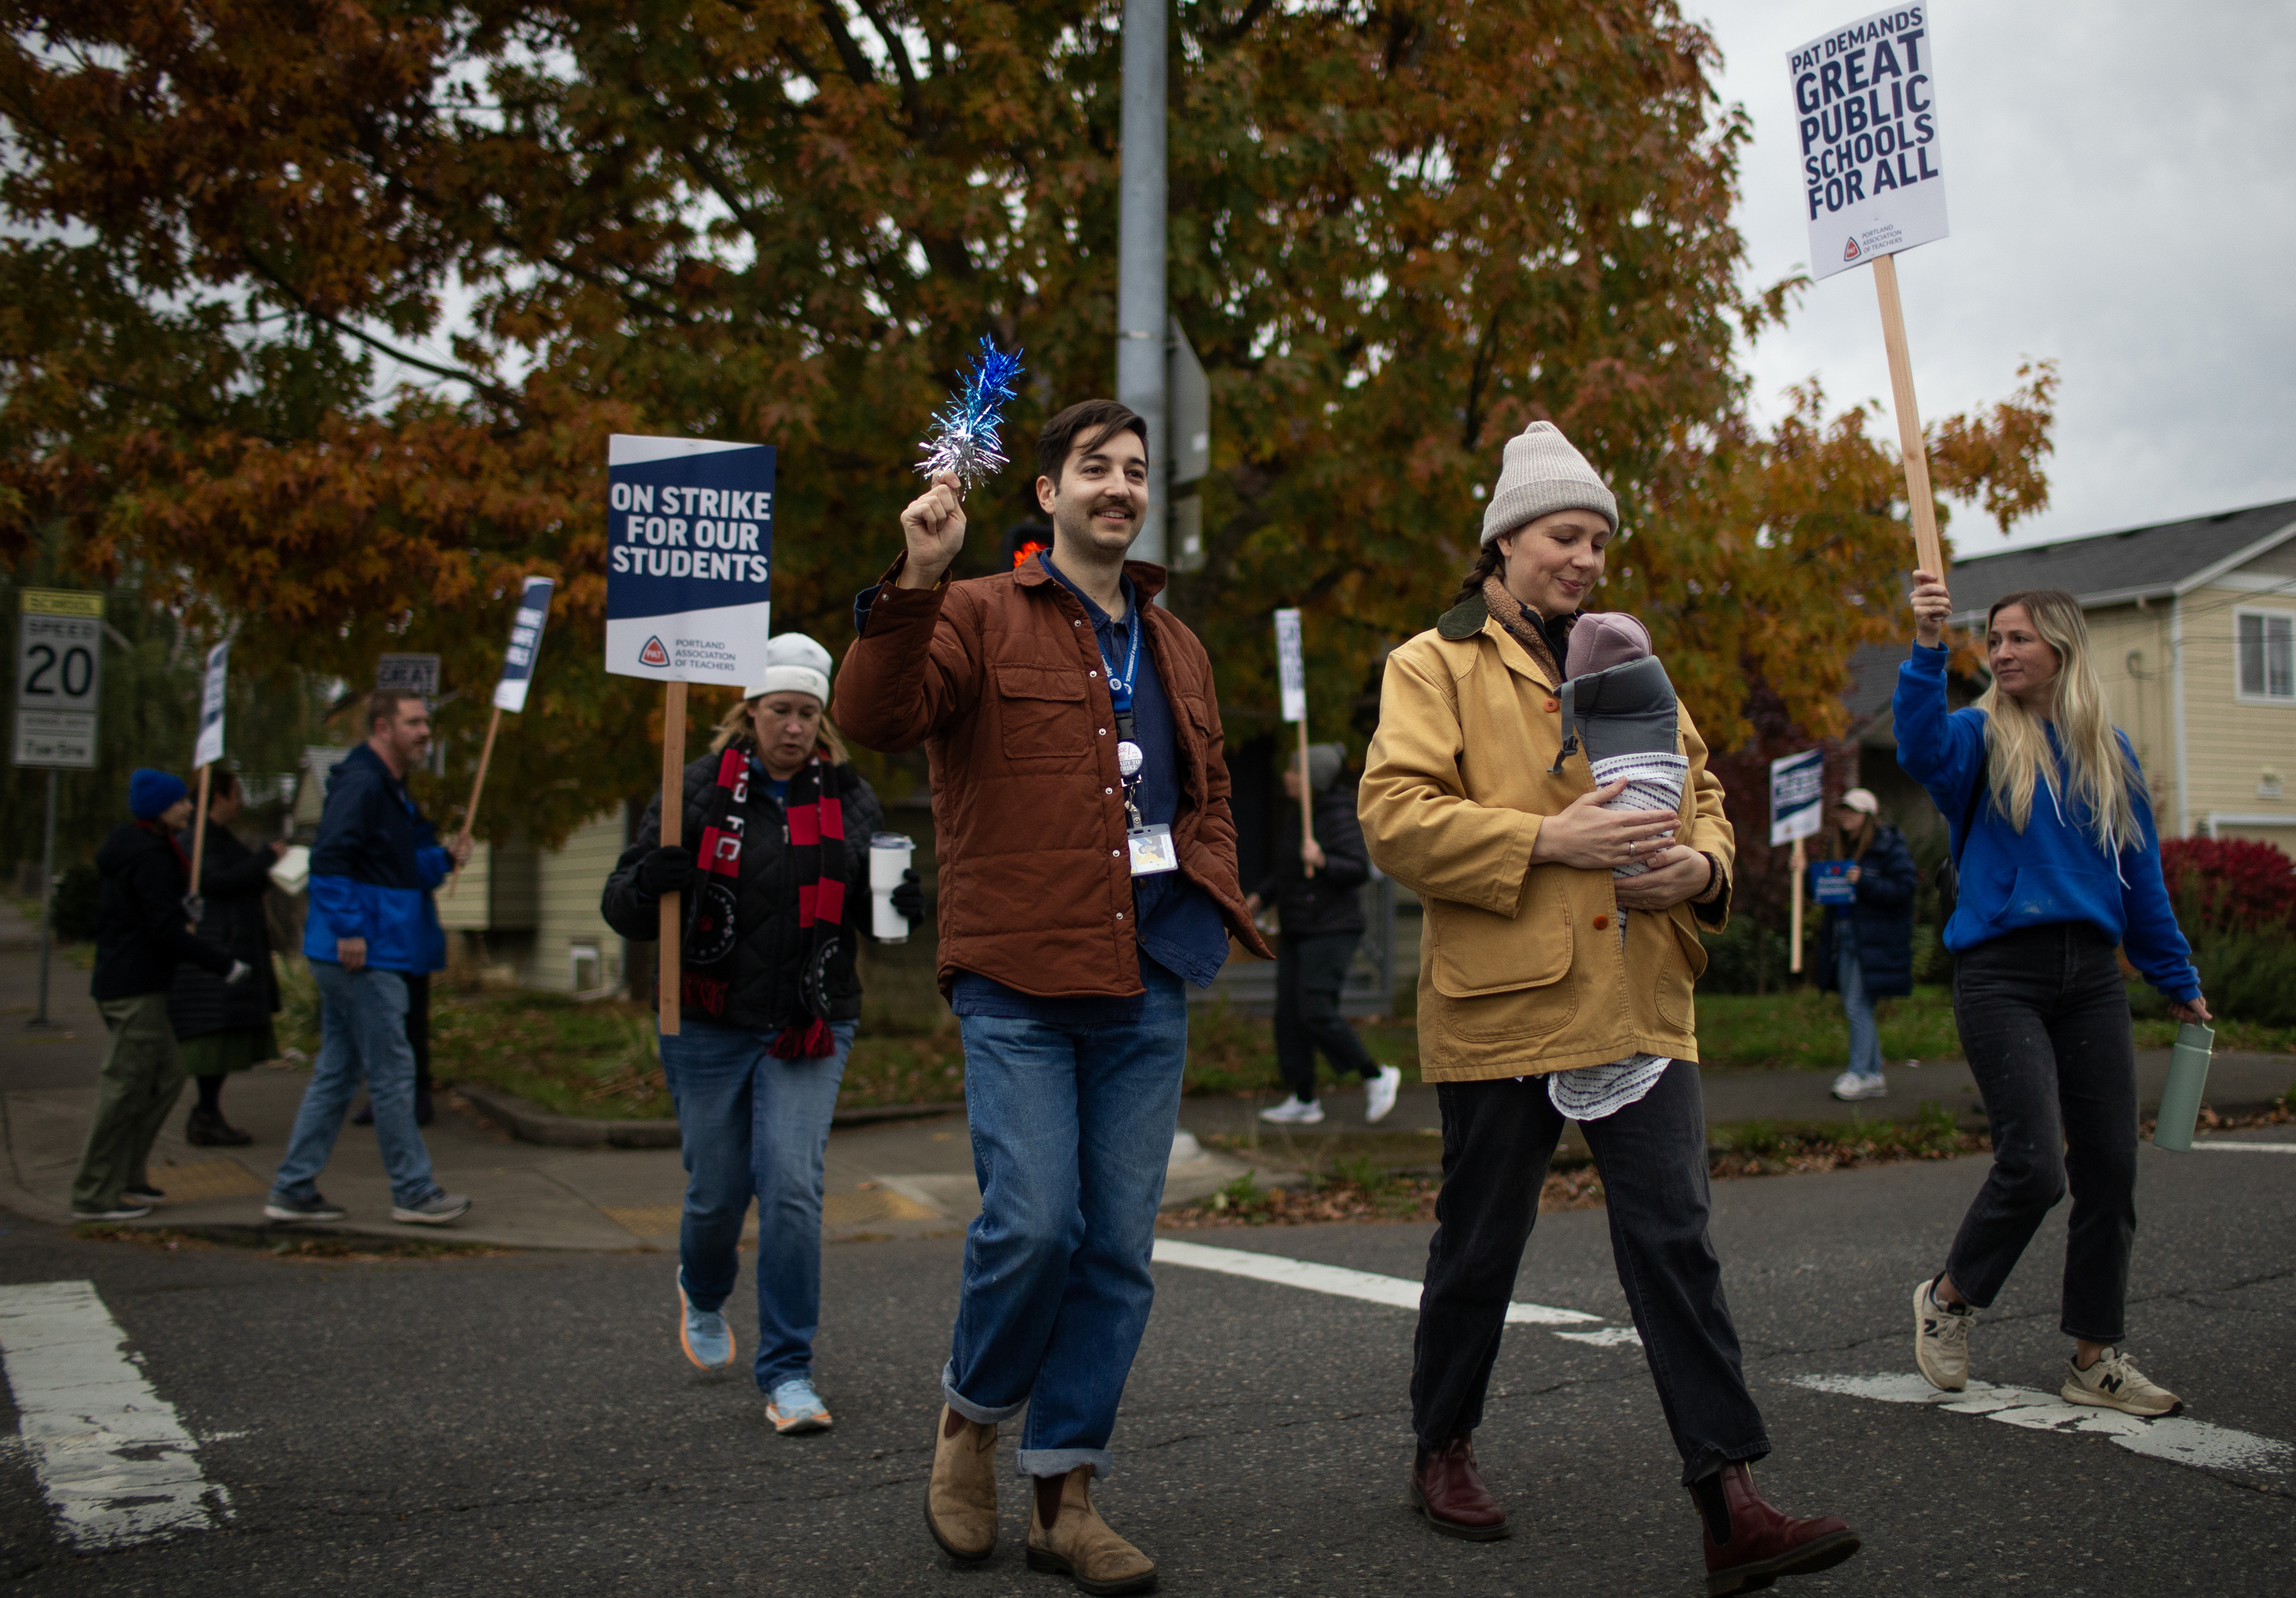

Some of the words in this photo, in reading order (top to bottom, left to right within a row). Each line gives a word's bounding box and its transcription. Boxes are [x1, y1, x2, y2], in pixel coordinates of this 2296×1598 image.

[1791, 44, 1821, 74] PAT
[1825, 6, 1923, 59] DEMANDS
[1795, 28, 1924, 116] GREAT
[1800, 73, 1930, 156] PUBLIC
[1805, 114, 1934, 186] SCHOOLS
[1807, 169, 1865, 221] FOR
[1873, 146, 1939, 196] ALL
[1862, 224, 1894, 239] PORTLAND
[1863, 230, 1902, 246] ASSOCIATION
[1871, 237, 1903, 251] TEACHERS
[611, 482, 654, 513] ON
[661, 486, 771, 521] STRIKE
[626, 515, 689, 546] FOR
[694, 520, 760, 551] OUR
[612, 546, 768, 583] STUDENTS
[675, 639, 726, 650] PORTLAND
[675, 648, 736, 660] ASSOCIATION
[25, 643, 93, 697] 20
[690, 659, 735, 671] TEACHERS
[2099, 1373, 2123, 1394] N
